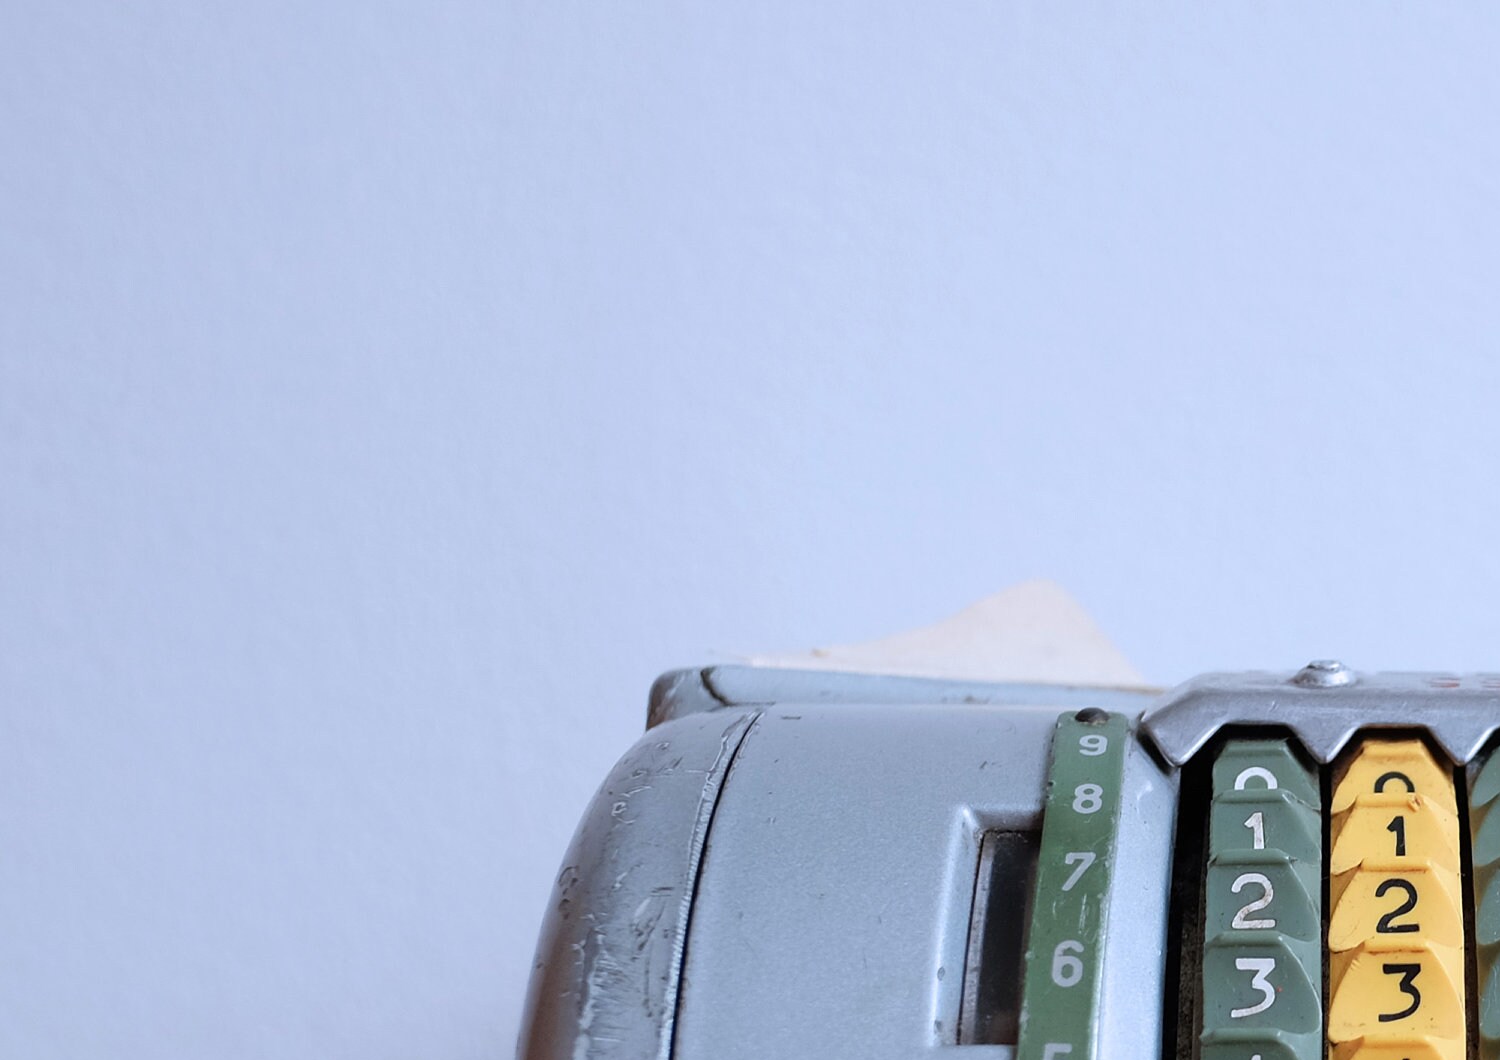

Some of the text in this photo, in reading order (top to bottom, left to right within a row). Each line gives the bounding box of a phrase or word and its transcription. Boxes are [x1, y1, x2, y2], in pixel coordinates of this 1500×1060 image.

[1079, 735, 1107, 755] 9
[1072, 783, 1103, 814] 8
[1244, 812, 1265, 849] 1
[1386, 816, 1406, 856] 1
[1062, 852, 1096, 891] 7
[1231, 873, 1276, 929] 2
[1375, 878, 1419, 933] 2
[1052, 940, 1084, 987] 6
[1230, 958, 1276, 1018] 3
[1378, 963, 1421, 1022] 3
